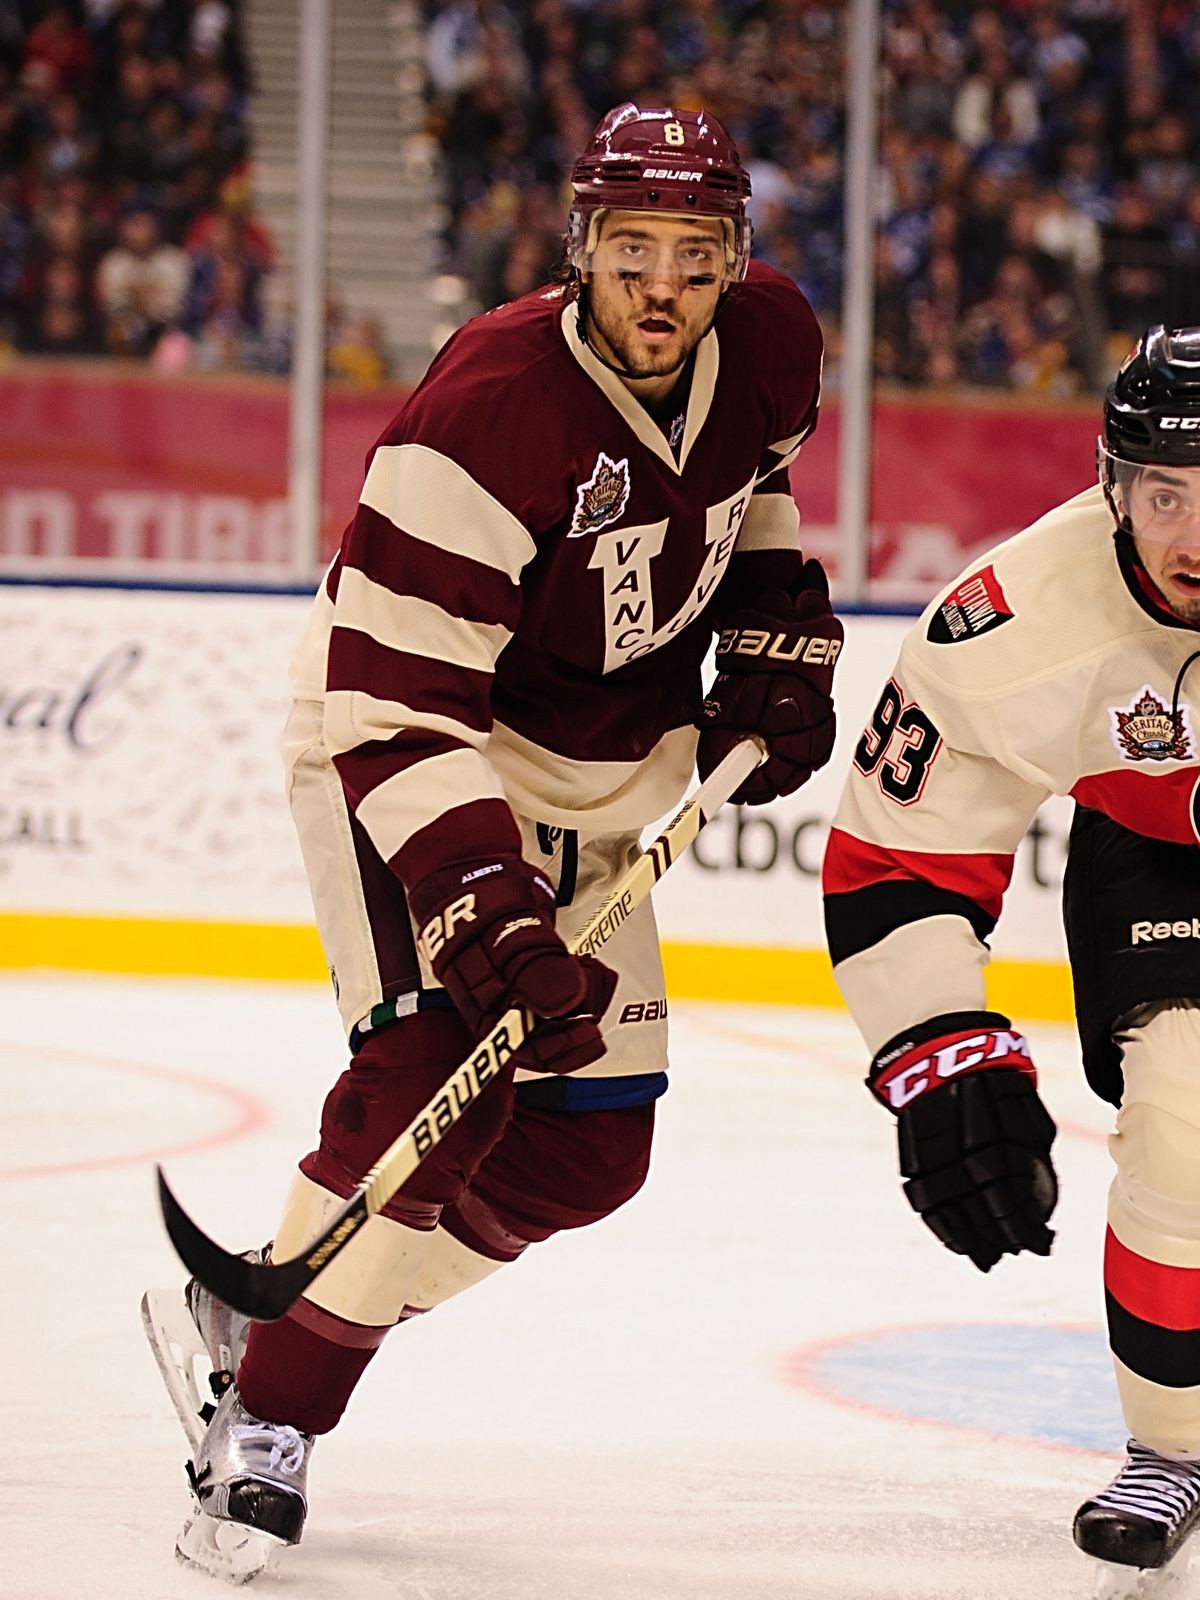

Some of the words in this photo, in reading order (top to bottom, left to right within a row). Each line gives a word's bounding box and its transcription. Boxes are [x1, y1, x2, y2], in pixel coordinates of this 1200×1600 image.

[664, 123, 684, 146] 8
[642, 168, 704, 182] BAUER
[957, 577, 997, 632] OTTAWA
[716, 629, 842, 666] BAUER
[852, 676, 944, 808] 93
[1125, 718, 1175, 736] HERITAG
[411, 1025, 515, 1160] BAUER
[885, 1031, 1031, 1109] CCM
